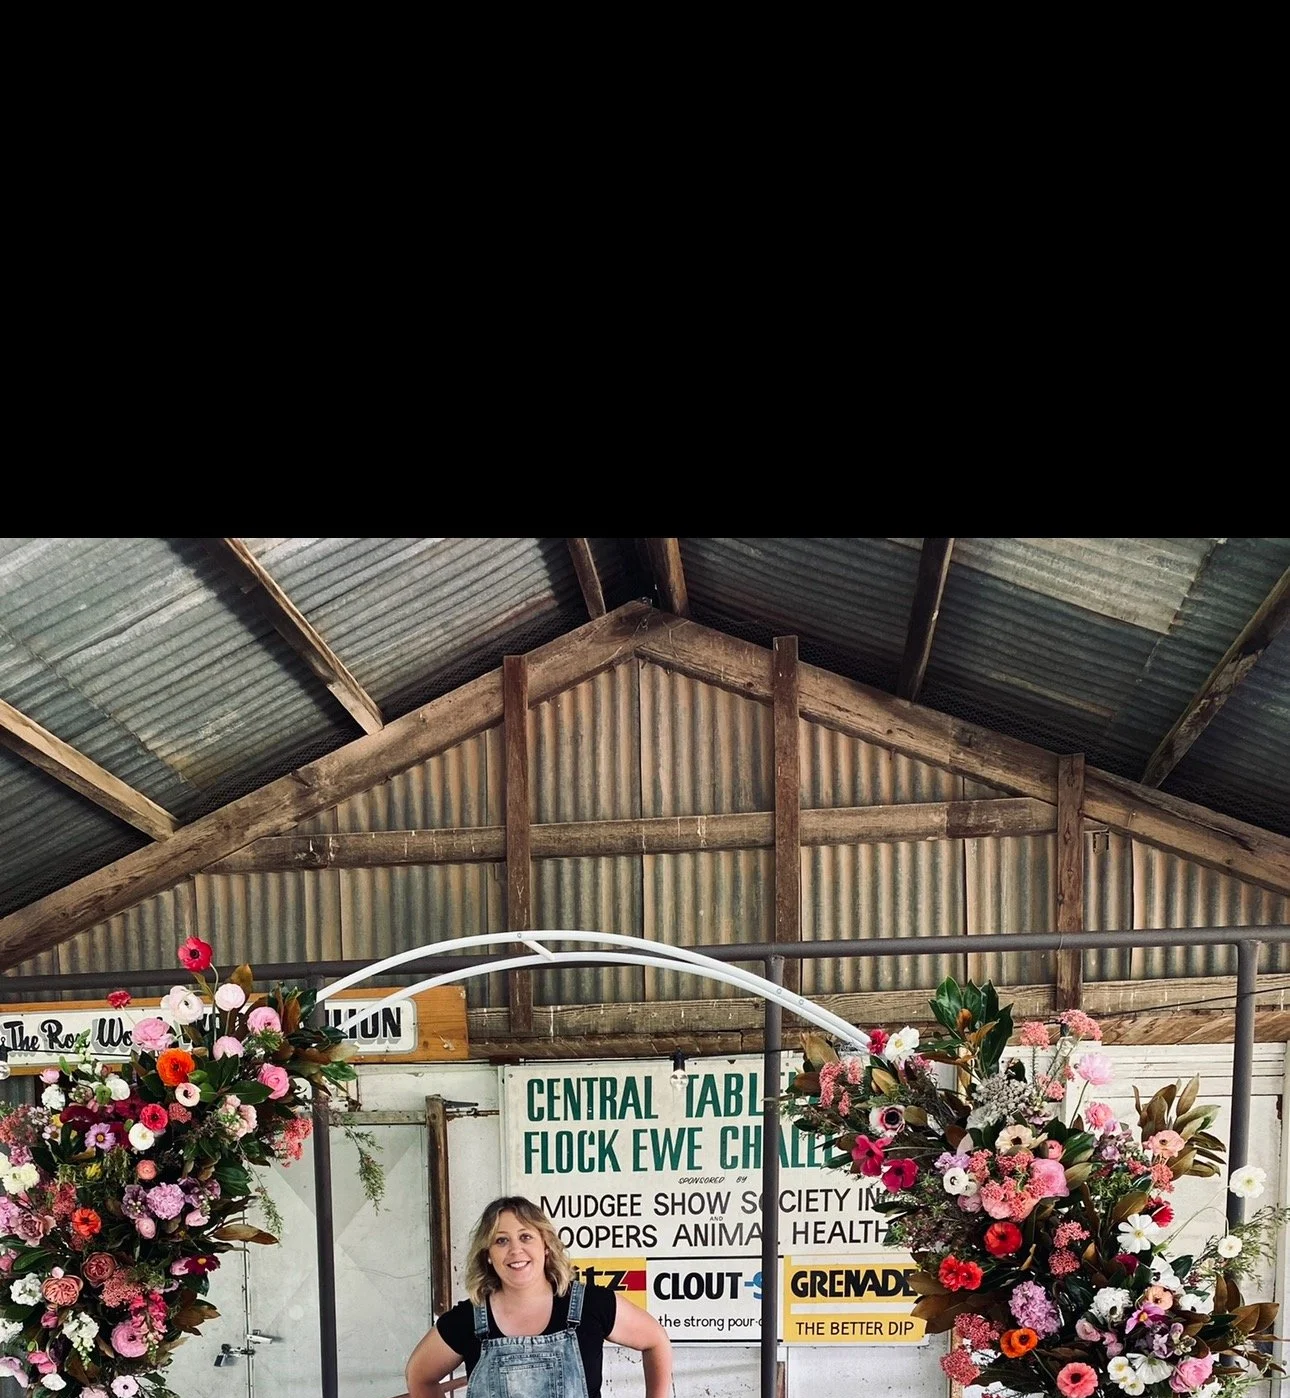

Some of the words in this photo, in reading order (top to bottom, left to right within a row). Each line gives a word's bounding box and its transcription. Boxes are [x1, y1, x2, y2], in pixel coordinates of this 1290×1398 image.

[3, 1021, 40, 1050] The
[527, 1076, 659, 1122] CENTRAL
[684, 1072, 798, 1119] TABL
[524, 1129, 622, 1174] FLOCK
[632, 1127, 703, 1172] EWE
[720, 1124, 834, 1170] CHLL
[678, 1176, 725, 1185] SPONSORED
[736, 1176, 748, 1184] BY
[540, 1194, 642, 1219] MUDGEE
[653, 1191, 732, 1216] SHOW
[741, 1188, 851, 1214] SCIETY
[557, 1224, 658, 1249] OOPERS
[672, 1222, 780, 1248] ANIMA
[792, 1220, 891, 1244] HEALTH
[790, 1268, 918, 1298] GRENADE
[658, 1314, 681, 1327] the
[684, 1316, 724, 1331] strong
[728, 1318, 763, 1331] pour-
[796, 1322, 825, 1335] THE
[830, 1321, 884, 1336] BETTER
[888, 1321, 914, 1336] DIP
